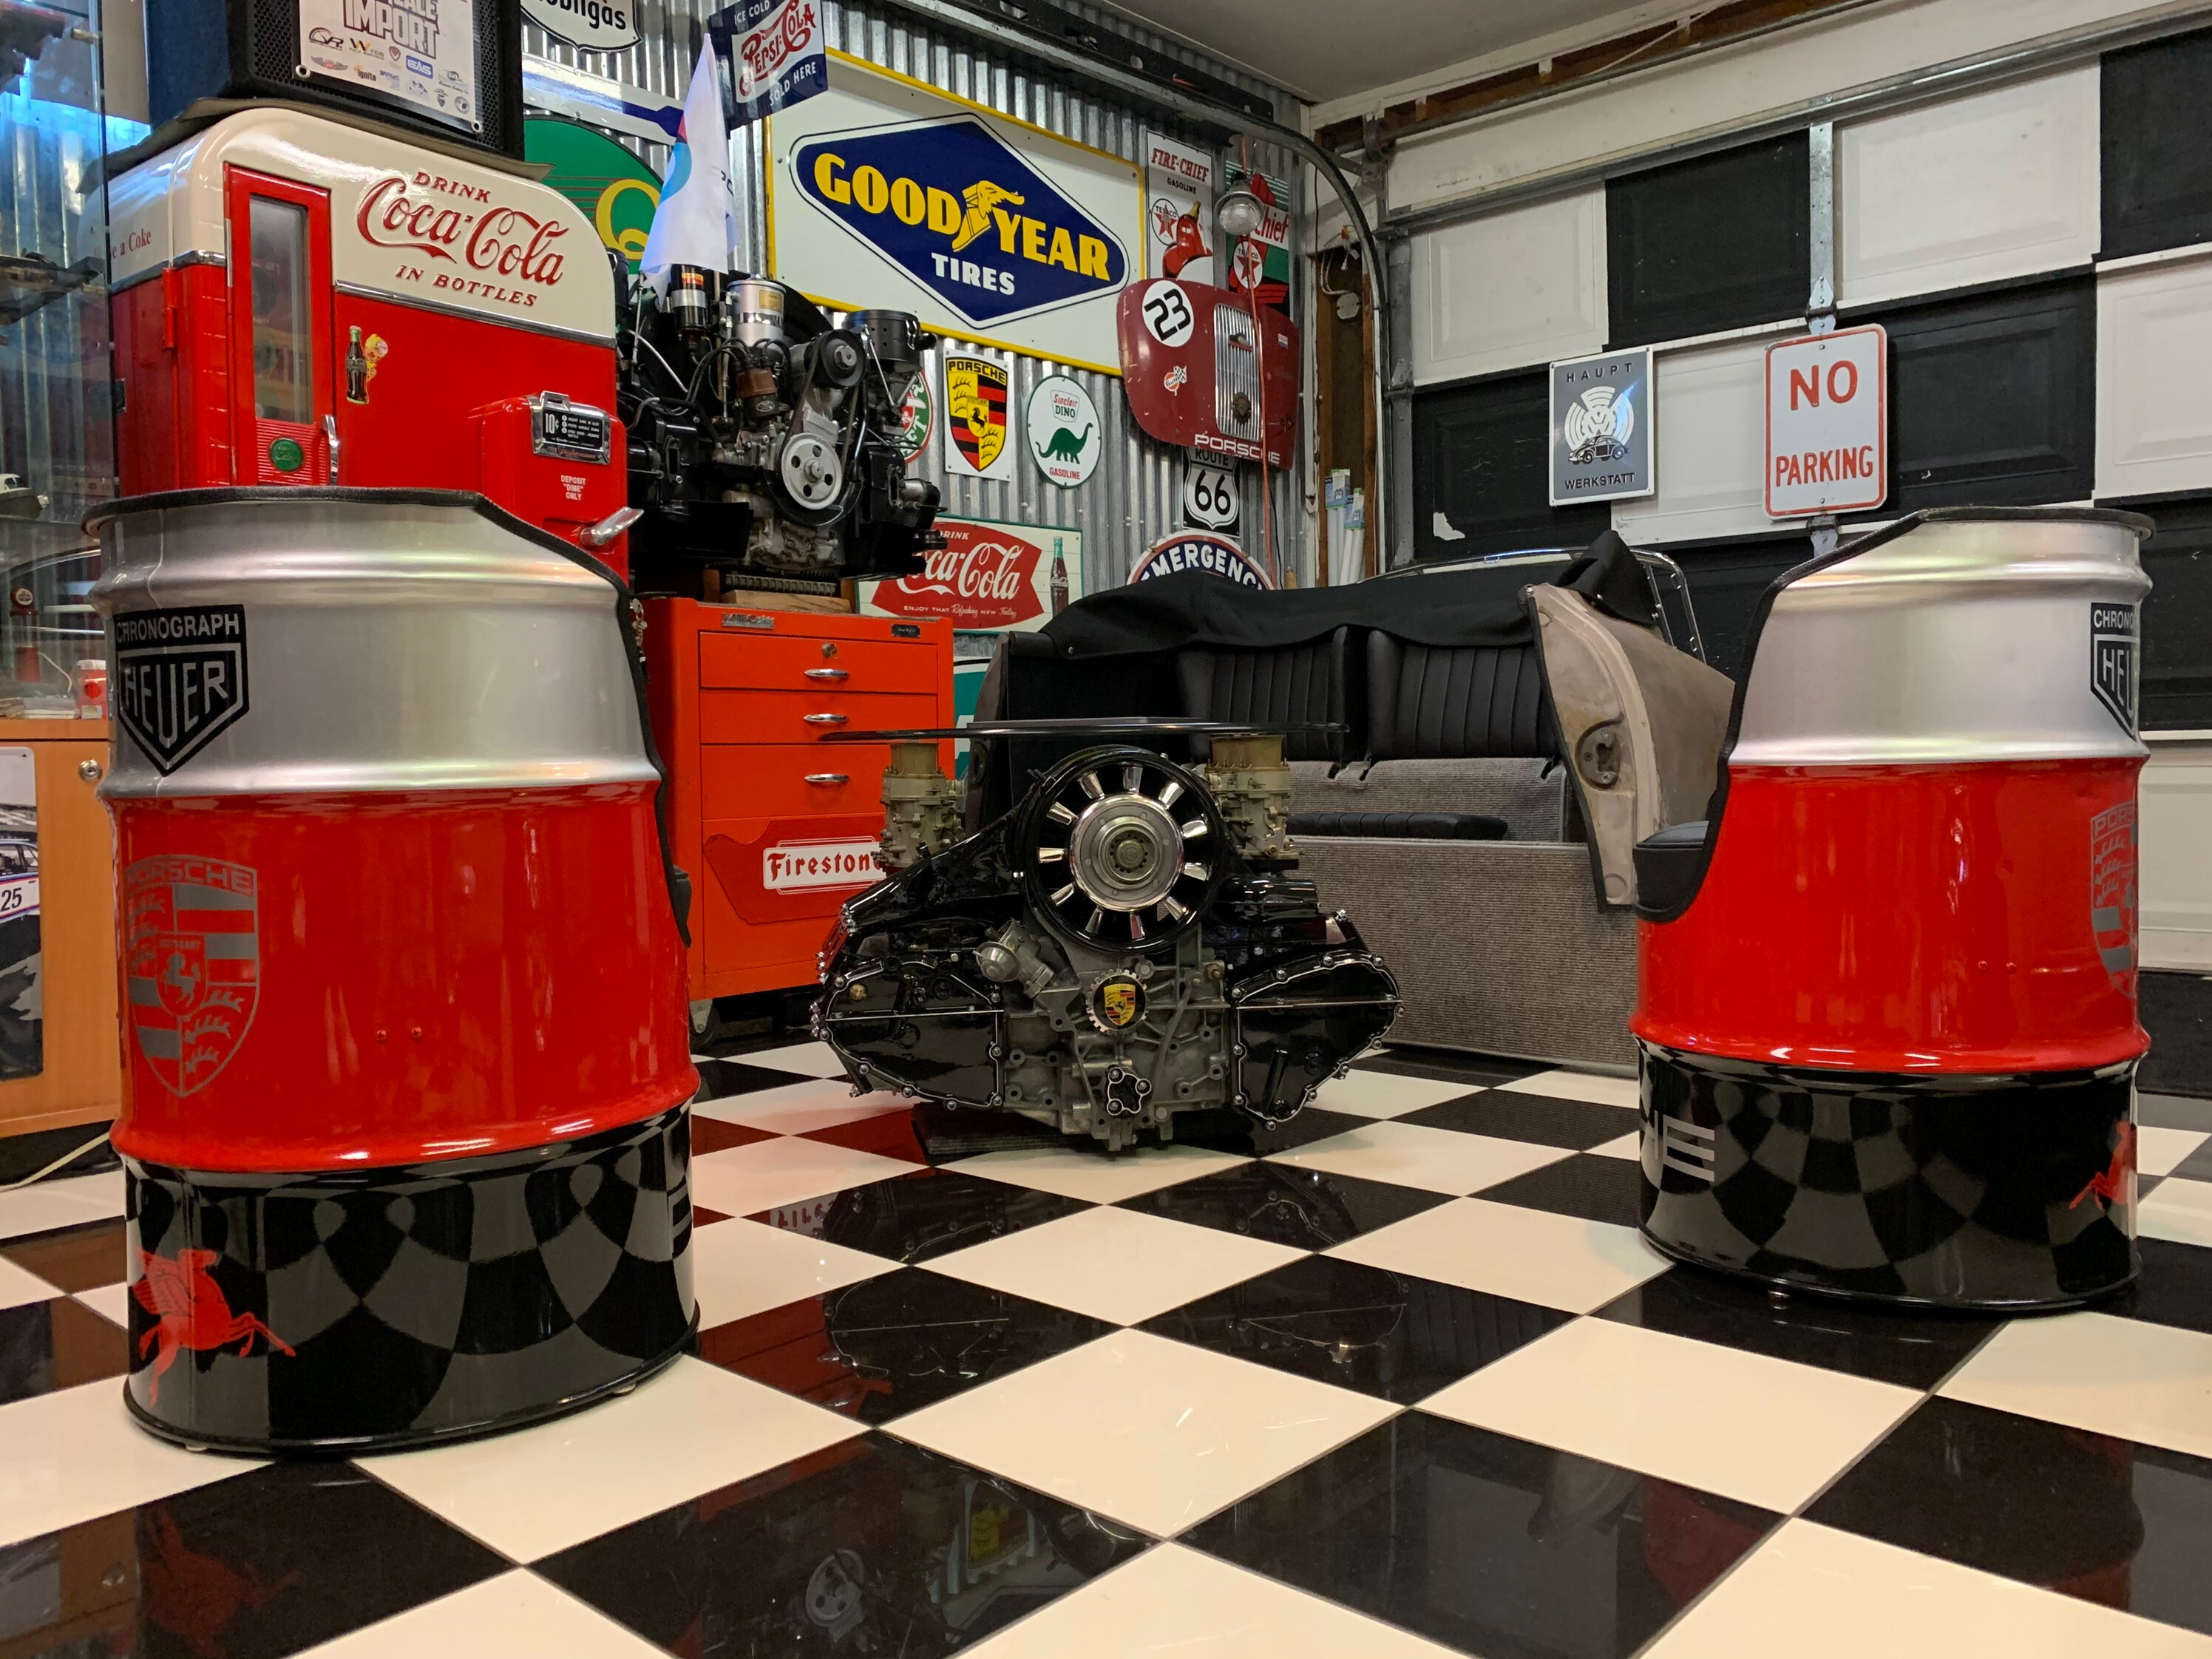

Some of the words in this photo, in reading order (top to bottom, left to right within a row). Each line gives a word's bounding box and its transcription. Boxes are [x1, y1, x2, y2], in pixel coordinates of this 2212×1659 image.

[734, 10, 747, 25] ICE
[748, 1, 770, 18] COLD
[770, 79, 790, 106] SOLD
[793, 62, 816, 84] HERE
[413, 172, 492, 203] DRINK
[1167, 177, 1197, 194] GASOLINE
[129, 228, 152, 251] Coke
[357, 177, 570, 286] Coca-Cola
[396, 265, 424, 281] IN
[432, 274, 537, 308] BOTTLES
[932, 253, 1015, 295] TIRES
[1144, 288, 1192, 342] 23
[949, 360, 1006, 383] PORSCHE
[1790, 359, 1859, 411] NO
[1053, 393, 1078, 407] Sinclair
[1055, 404, 1076, 418] DINO
[1195, 447, 1229, 467] ROUTE
[1775, 445, 1873, 487] PARKING
[560, 475, 586, 485] DEPOSIT
[1049, 467, 1081, 480] GASOLINE
[1564, 472, 1636, 491] WERKSTATT
[566, 492, 582, 501] ONLY
[1195, 469, 1231, 516] 66
[117, 613, 241, 643] CHRONOGRAPH
[123, 661, 229, 749] HEUER
